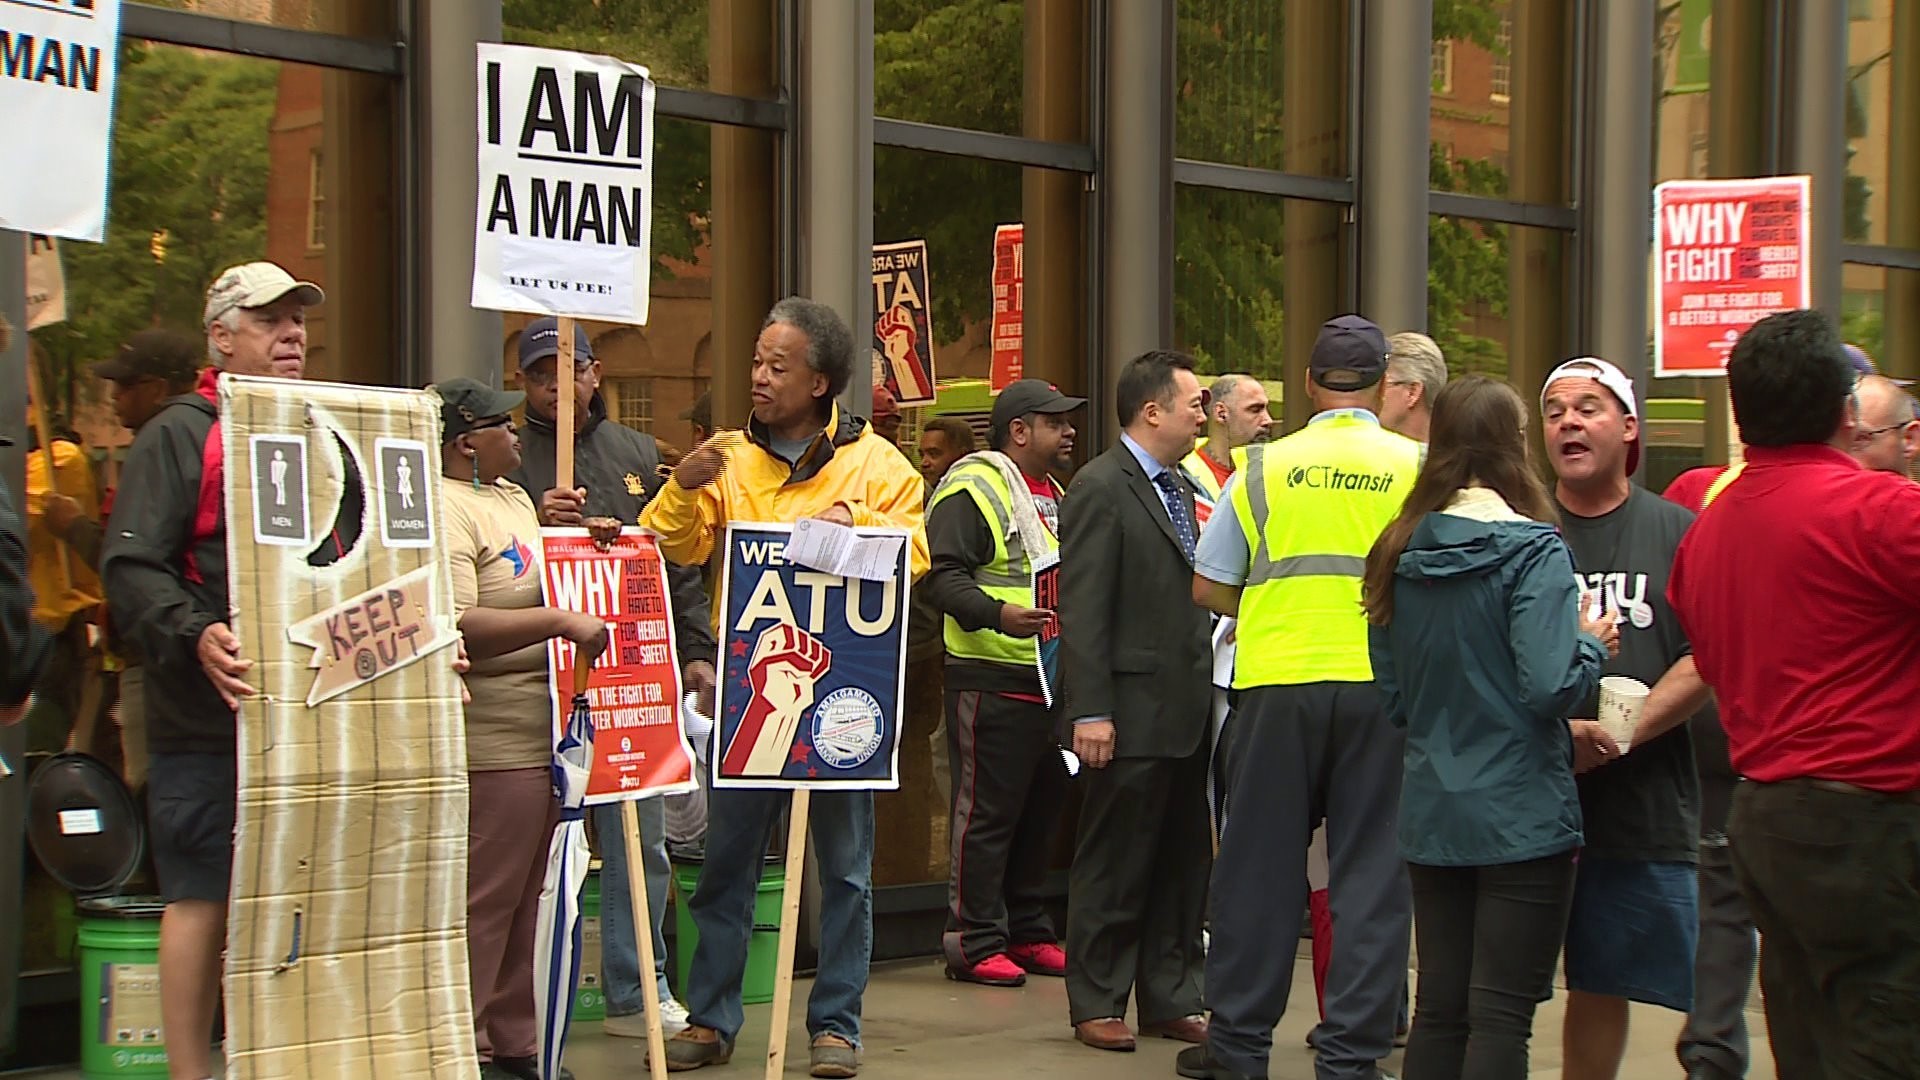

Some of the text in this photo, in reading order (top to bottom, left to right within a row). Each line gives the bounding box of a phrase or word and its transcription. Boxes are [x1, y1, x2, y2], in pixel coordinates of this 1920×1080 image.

[0, 29, 100, 92] MAN
[487, 61, 643, 159] I AM
[486, 174, 641, 247] A MAN
[1665, 201, 1748, 246] WHY
[1665, 247, 1736, 283] FIGHT
[509, 276, 612, 295] LET US PEE!
[271, 516, 292, 528] MEN
[391, 519, 425, 530] WOMEN
[739, 540, 784, 566] WE
[625, 559, 660, 576] MUST WE
[549, 558, 622, 617] WHY
[627, 578, 658, 595] ALWAYS
[628, 597, 663, 614] HAVE TO
[735, 569, 897, 637] ATU
[326, 589, 404, 661] KEEP
[620, 619, 667, 642] FOR HEALTH
[355, 623, 420, 680] OUT
[623, 644, 669, 666] AND SAFETY
[600, 687, 619, 706] THE
[619, 684, 643, 705] FIGHT
[644, 683, 663, 703] FOR
[817, 688, 880, 718] AMALGAMATED
[613, 705, 672, 728] WORKSTATION
[814, 734, 881, 766] TRANSIT UNION
